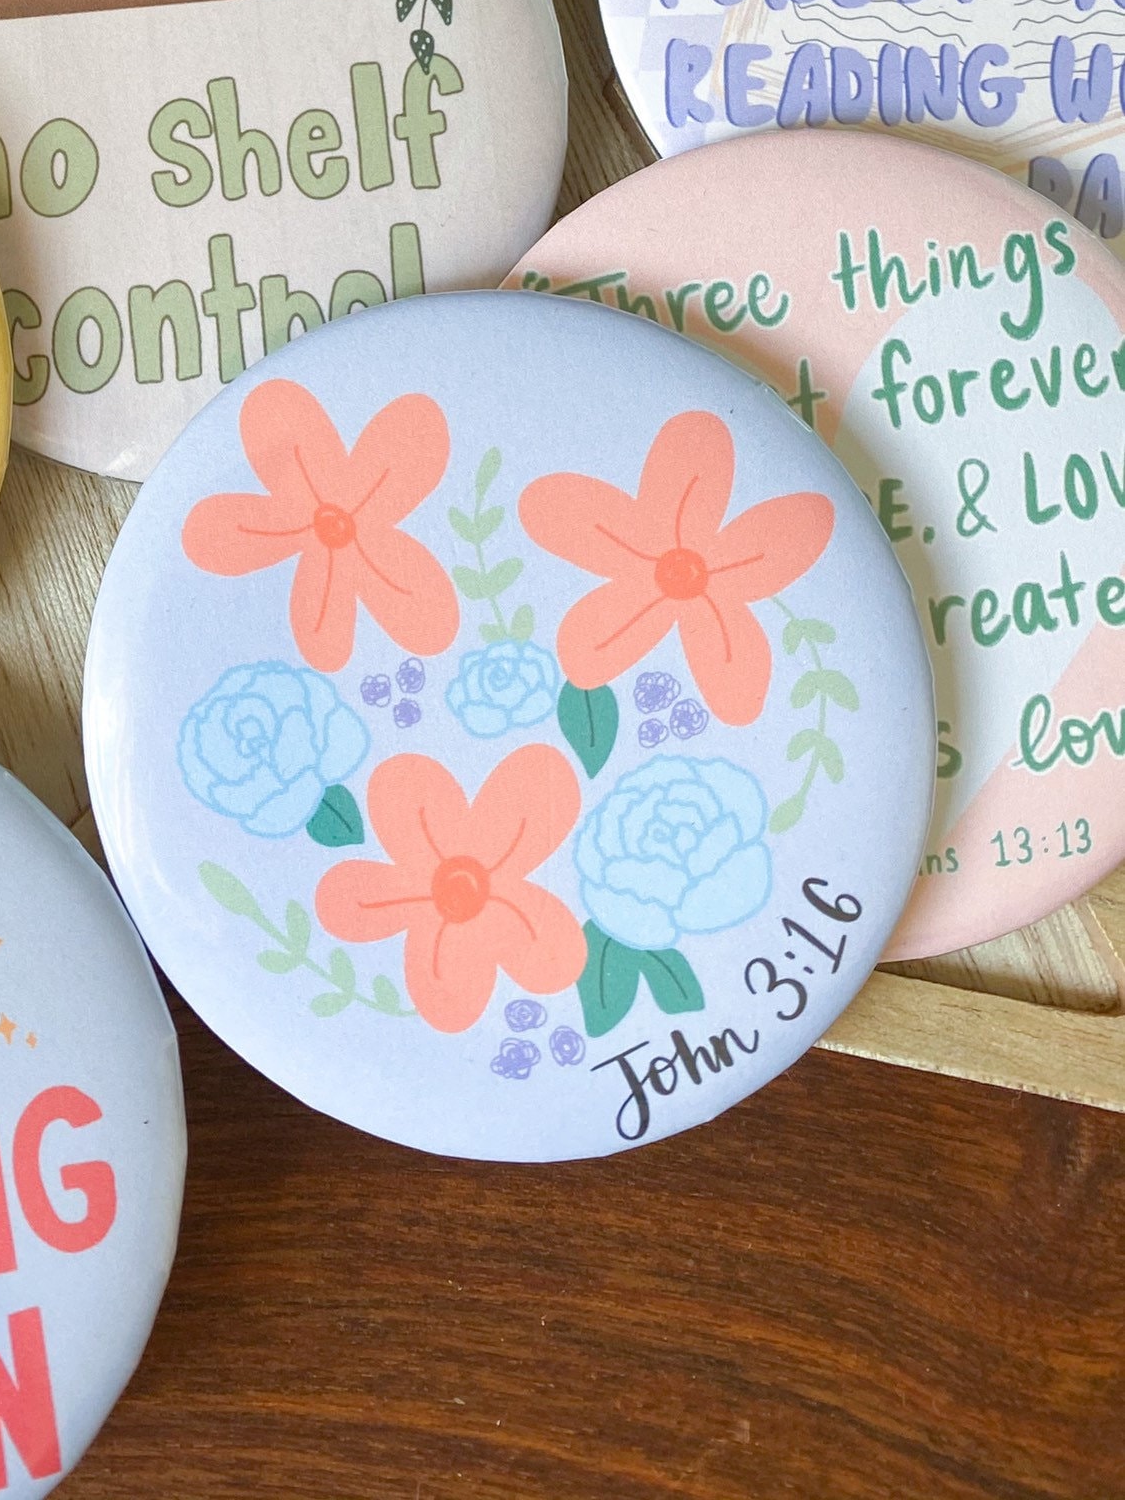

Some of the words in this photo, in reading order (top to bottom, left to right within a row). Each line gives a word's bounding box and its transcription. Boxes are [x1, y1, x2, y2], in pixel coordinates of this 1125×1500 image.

[148, 53, 463, 207] shelf
[665, 38, 1025, 128] READING
[832, 219, 1076, 340] things
[956, 458, 998, 537] &
[990, 817, 1092, 867] 13:13
[590, 1028, 759, 1140] John
[744, 877, 862, 1021] 3:16
